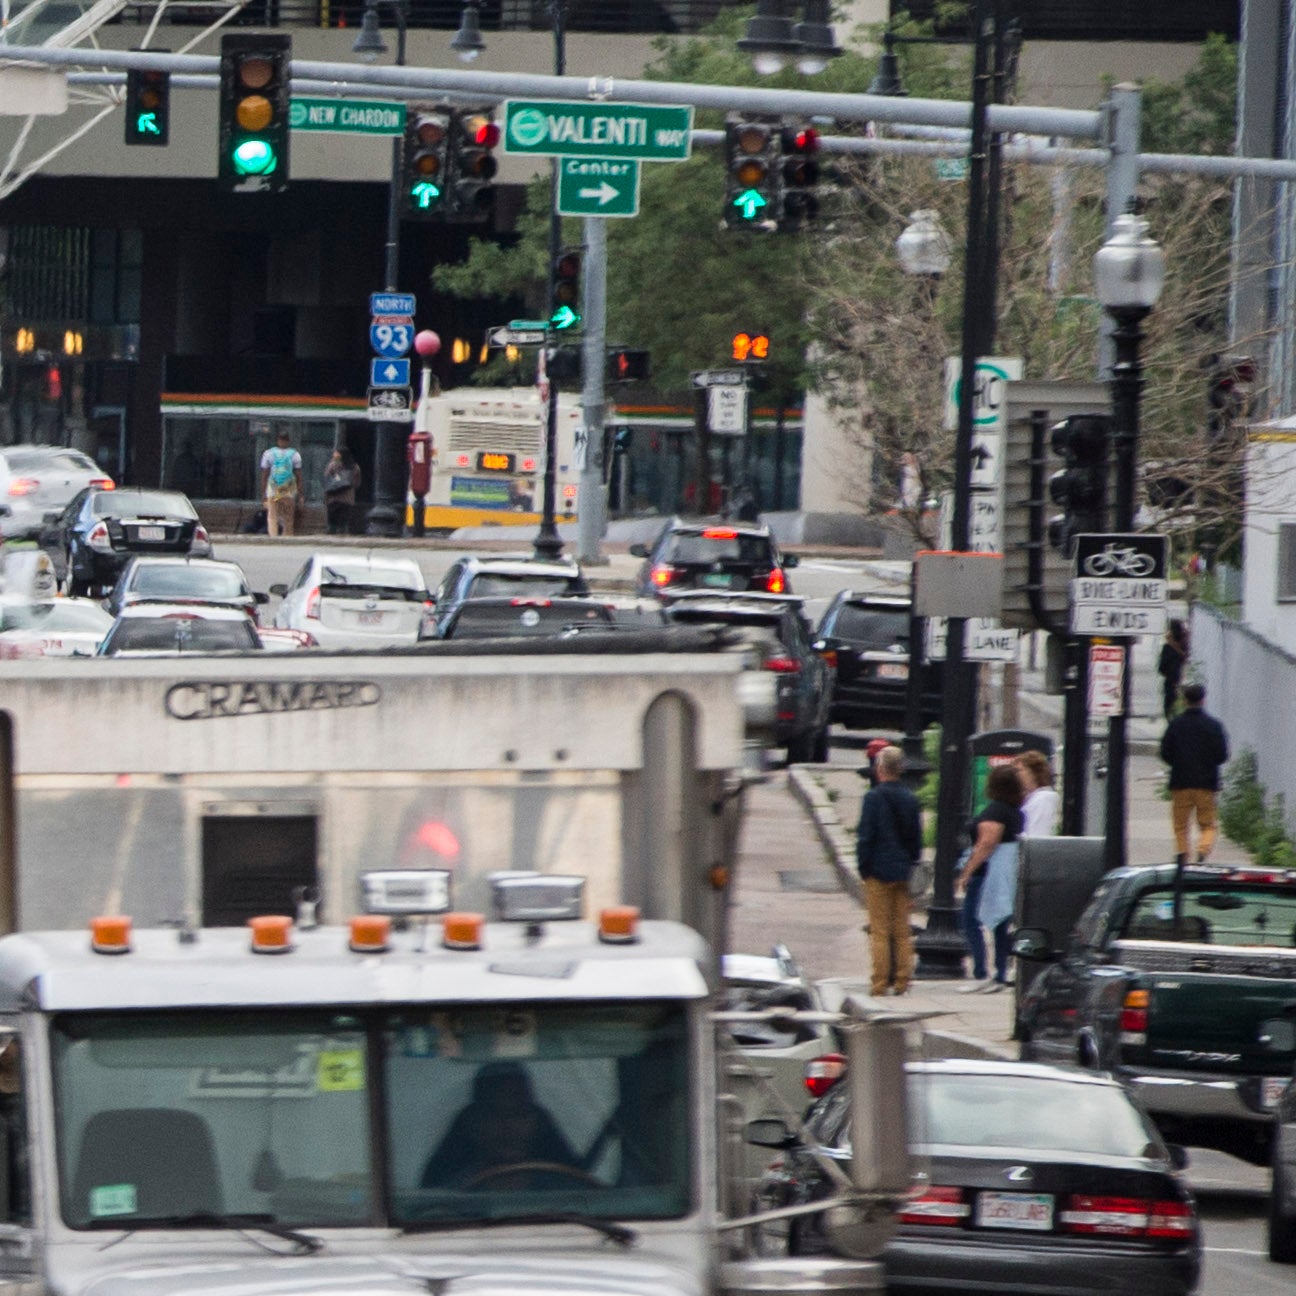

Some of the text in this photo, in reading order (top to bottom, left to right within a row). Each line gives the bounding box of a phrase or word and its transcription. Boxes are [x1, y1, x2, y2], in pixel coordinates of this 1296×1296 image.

[309, 106, 400, 127] NEW CHARDON
[546, 115, 687, 147] VALENTI WAY
[567, 160, 629, 175] Center
[376, 326, 409, 352] 93
[164, 680, 383, 720] CRAMARO
